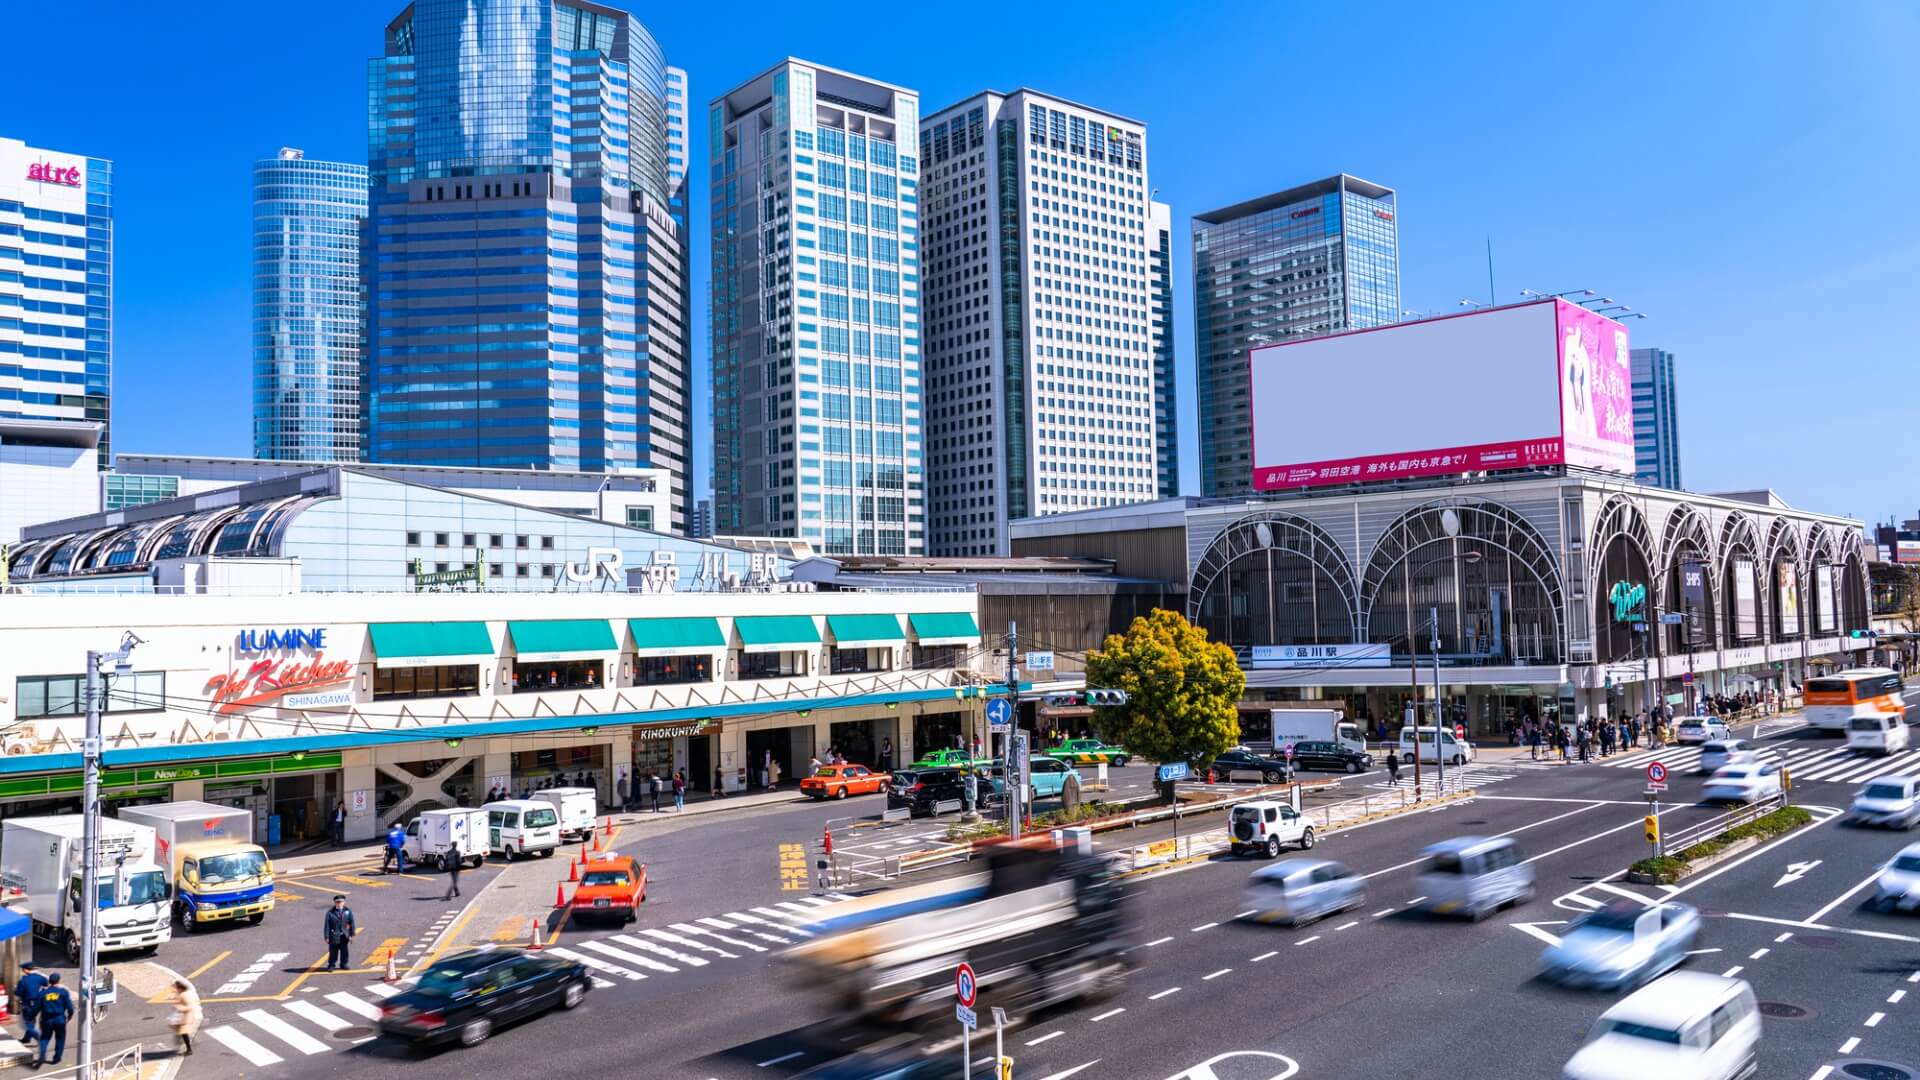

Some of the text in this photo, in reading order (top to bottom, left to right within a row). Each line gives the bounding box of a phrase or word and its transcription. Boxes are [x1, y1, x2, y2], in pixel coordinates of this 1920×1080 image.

[29, 161, 80, 185] atré
[1266, 472, 1286, 483] 品川
[1319, 465, 1361, 479] 羽田空港
[566, 546, 780, 584] JR 品川駅
[240, 628, 327, 651] LUMINE
[1297, 647, 1337, 657] 品川駅
[207, 651, 353, 712] The Kitchen
[288, 694, 351, 707] SHINAGAWA
[640, 724, 700, 740] KINOKUNIYA
[154, 767, 201, 780] NewDays
